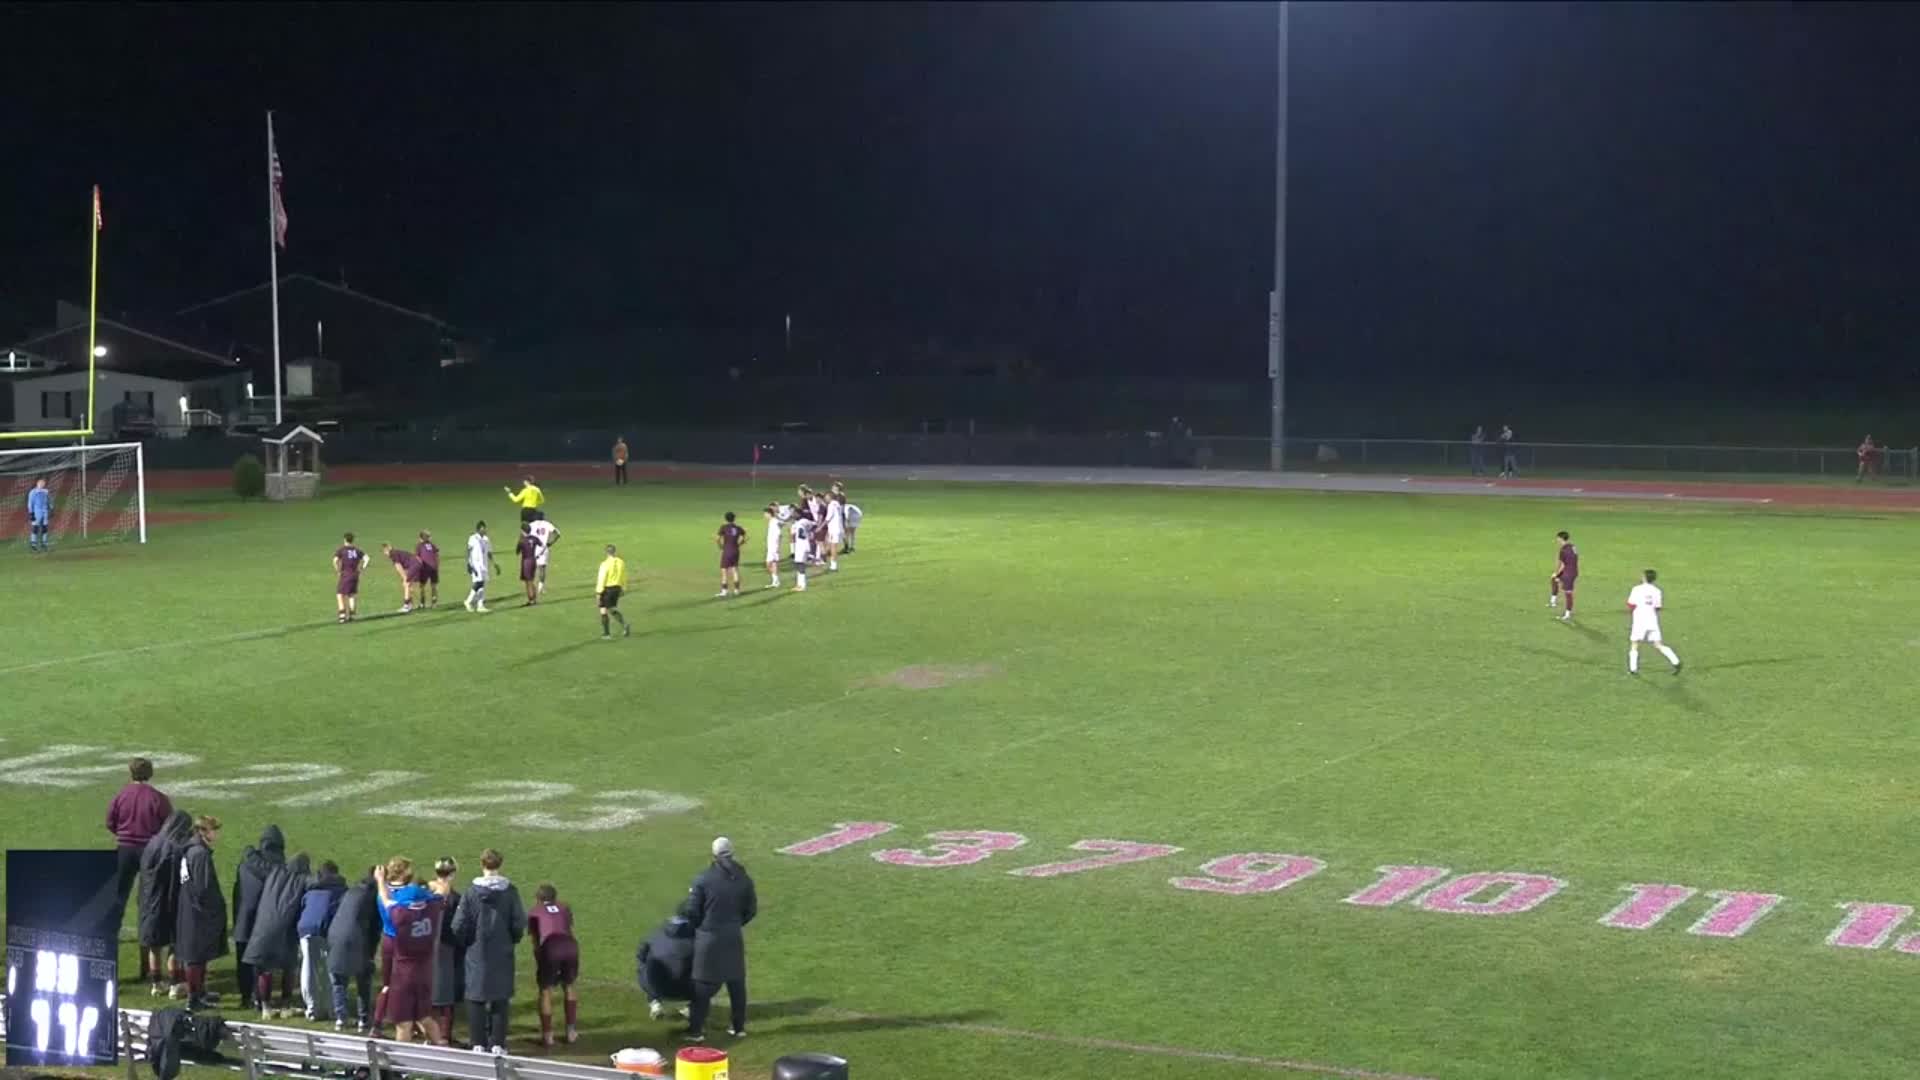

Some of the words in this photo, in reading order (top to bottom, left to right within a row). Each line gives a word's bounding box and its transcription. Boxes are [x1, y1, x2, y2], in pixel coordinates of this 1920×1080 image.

[776, 820, 897, 856] 1
[871, 829, 1028, 868] 3
[1007, 839, 1186, 877] 7
[1168, 852, 1328, 895] 9
[1341, 864, 1569, 916] 10
[1597, 882, 1785, 938] 11
[410, 918, 433, 938] 20
